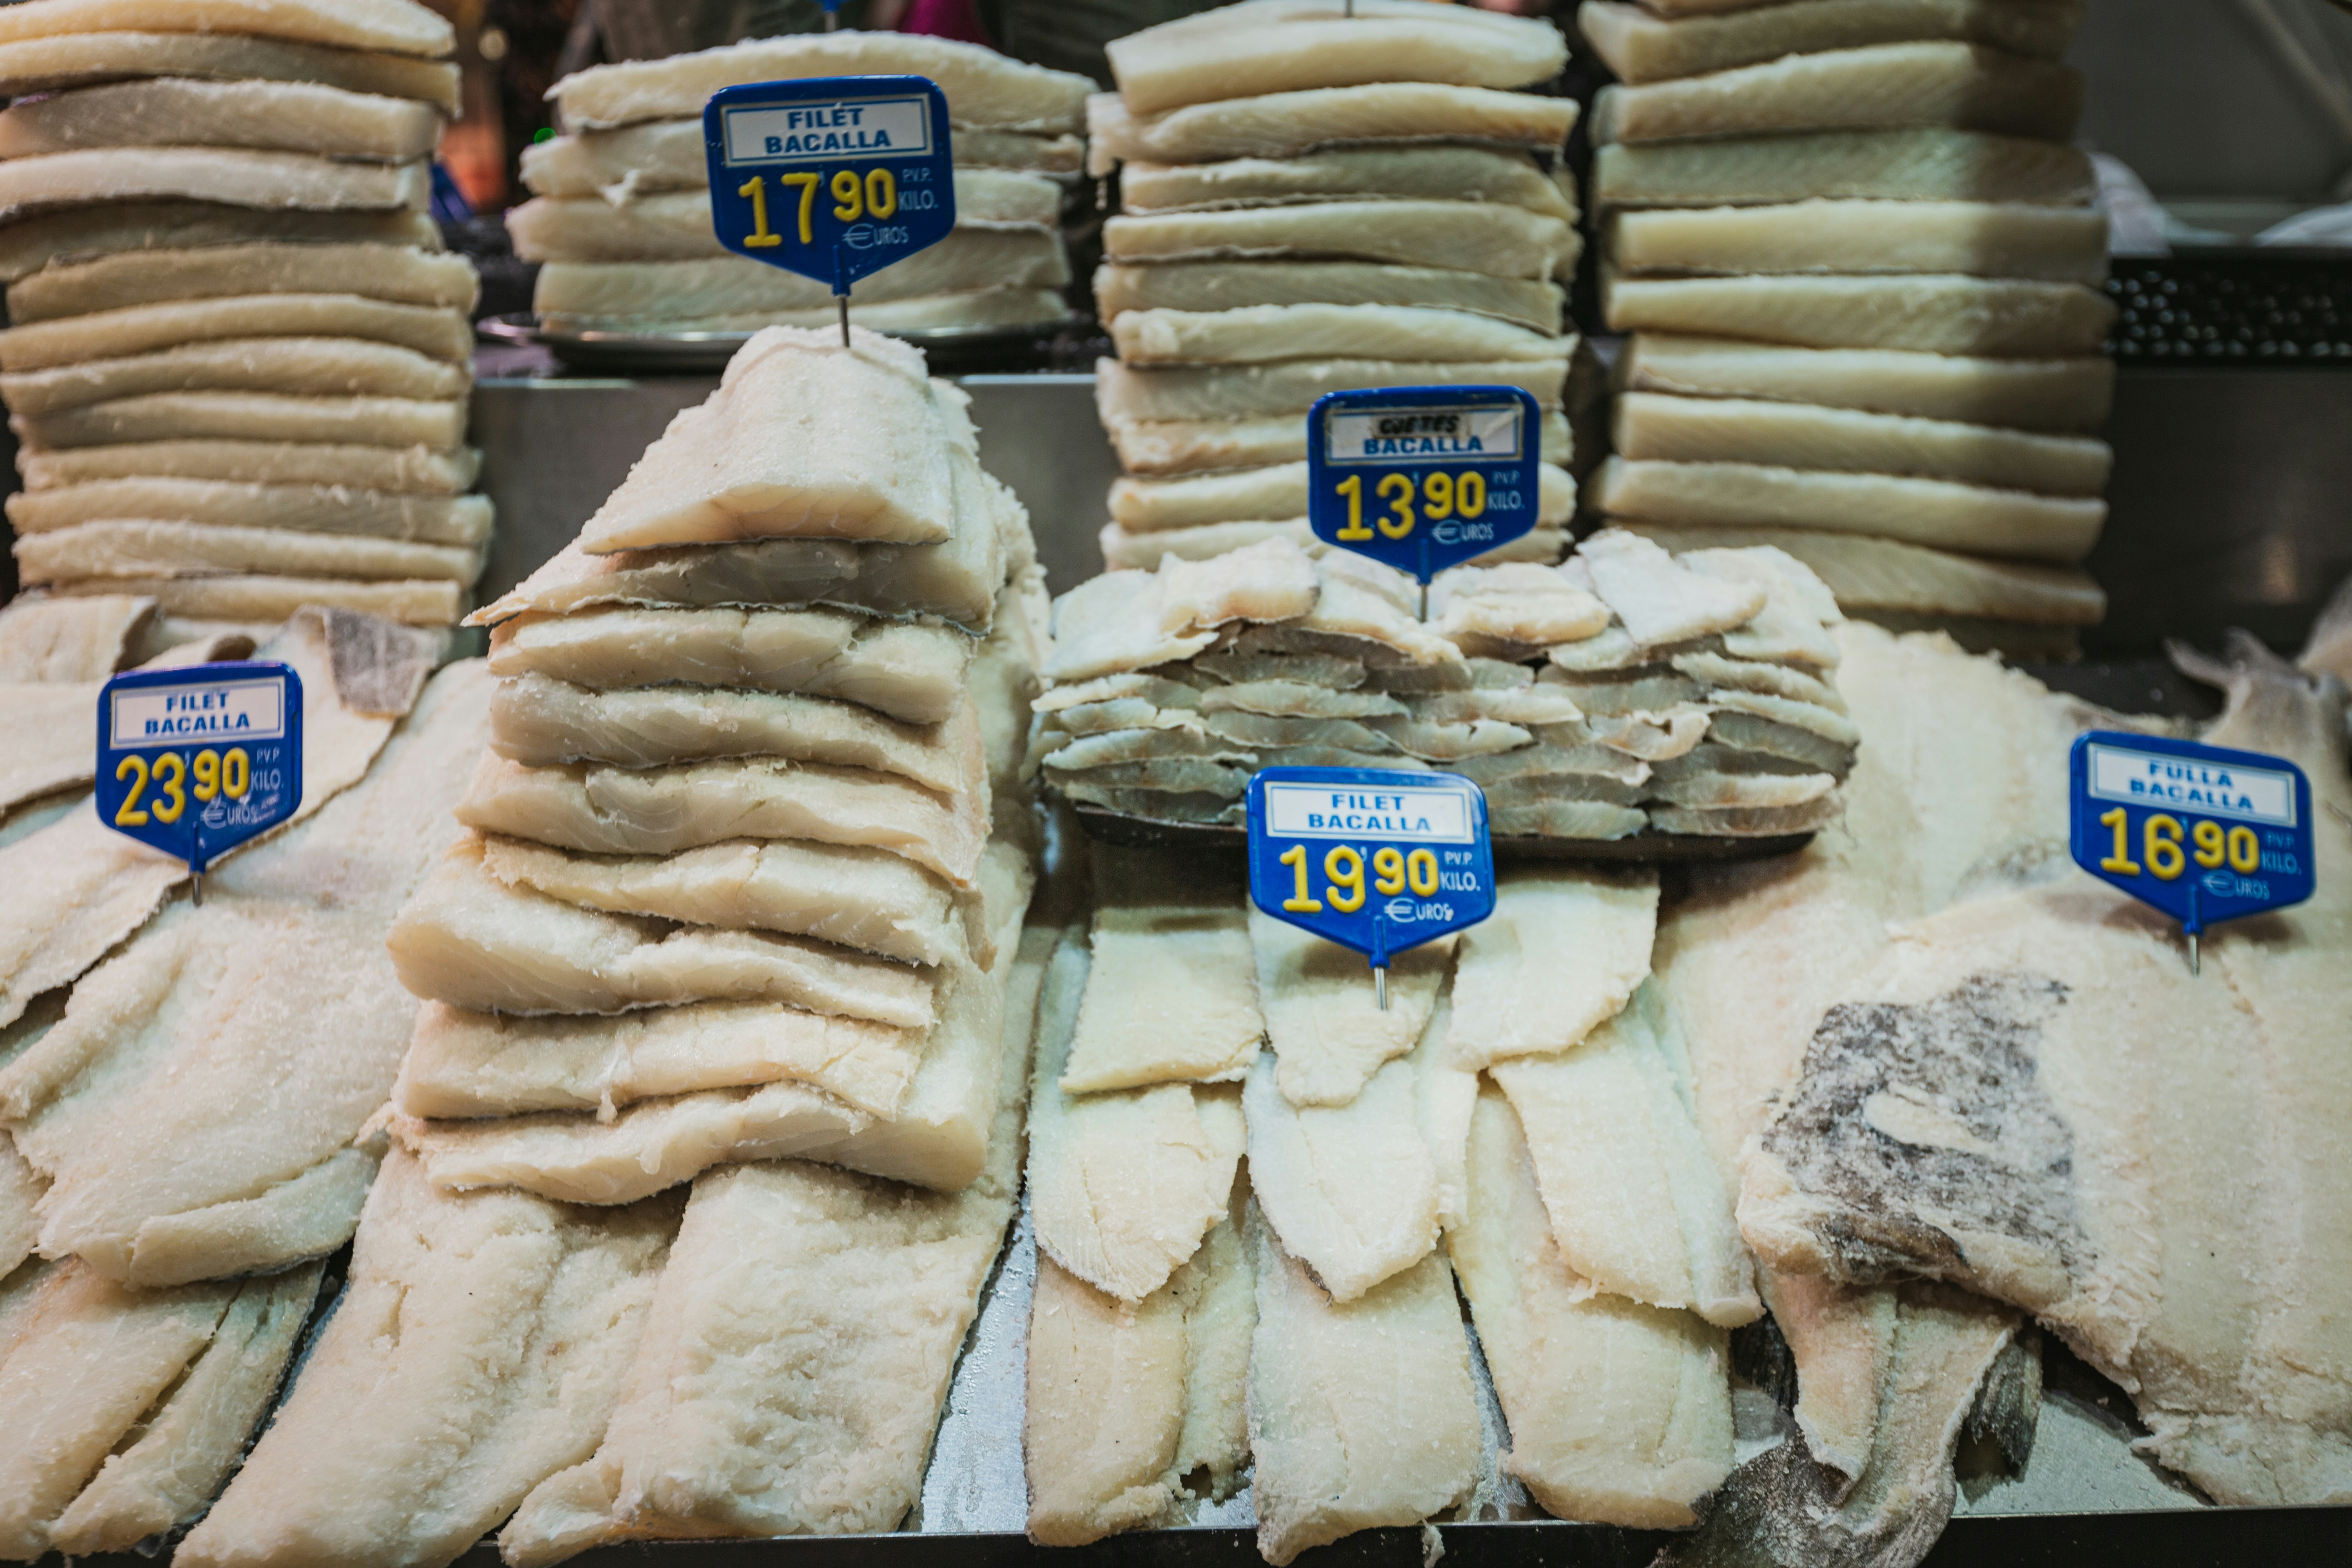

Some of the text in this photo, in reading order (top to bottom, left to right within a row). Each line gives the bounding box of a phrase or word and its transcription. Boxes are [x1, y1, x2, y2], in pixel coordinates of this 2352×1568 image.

[787, 107, 864, 129] FILET
[765, 129, 891, 154] BACALLA
[1364, 436, 1483, 454] BACALLA
[166, 690, 229, 712] FILET
[145, 713, 249, 735] BACALLA
[2149, 760, 2234, 788] FULLA
[1332, 794, 1405, 811] FILET
[2131, 778, 2254, 812] BACALLA
[1308, 814, 1431, 832] BACALLA
